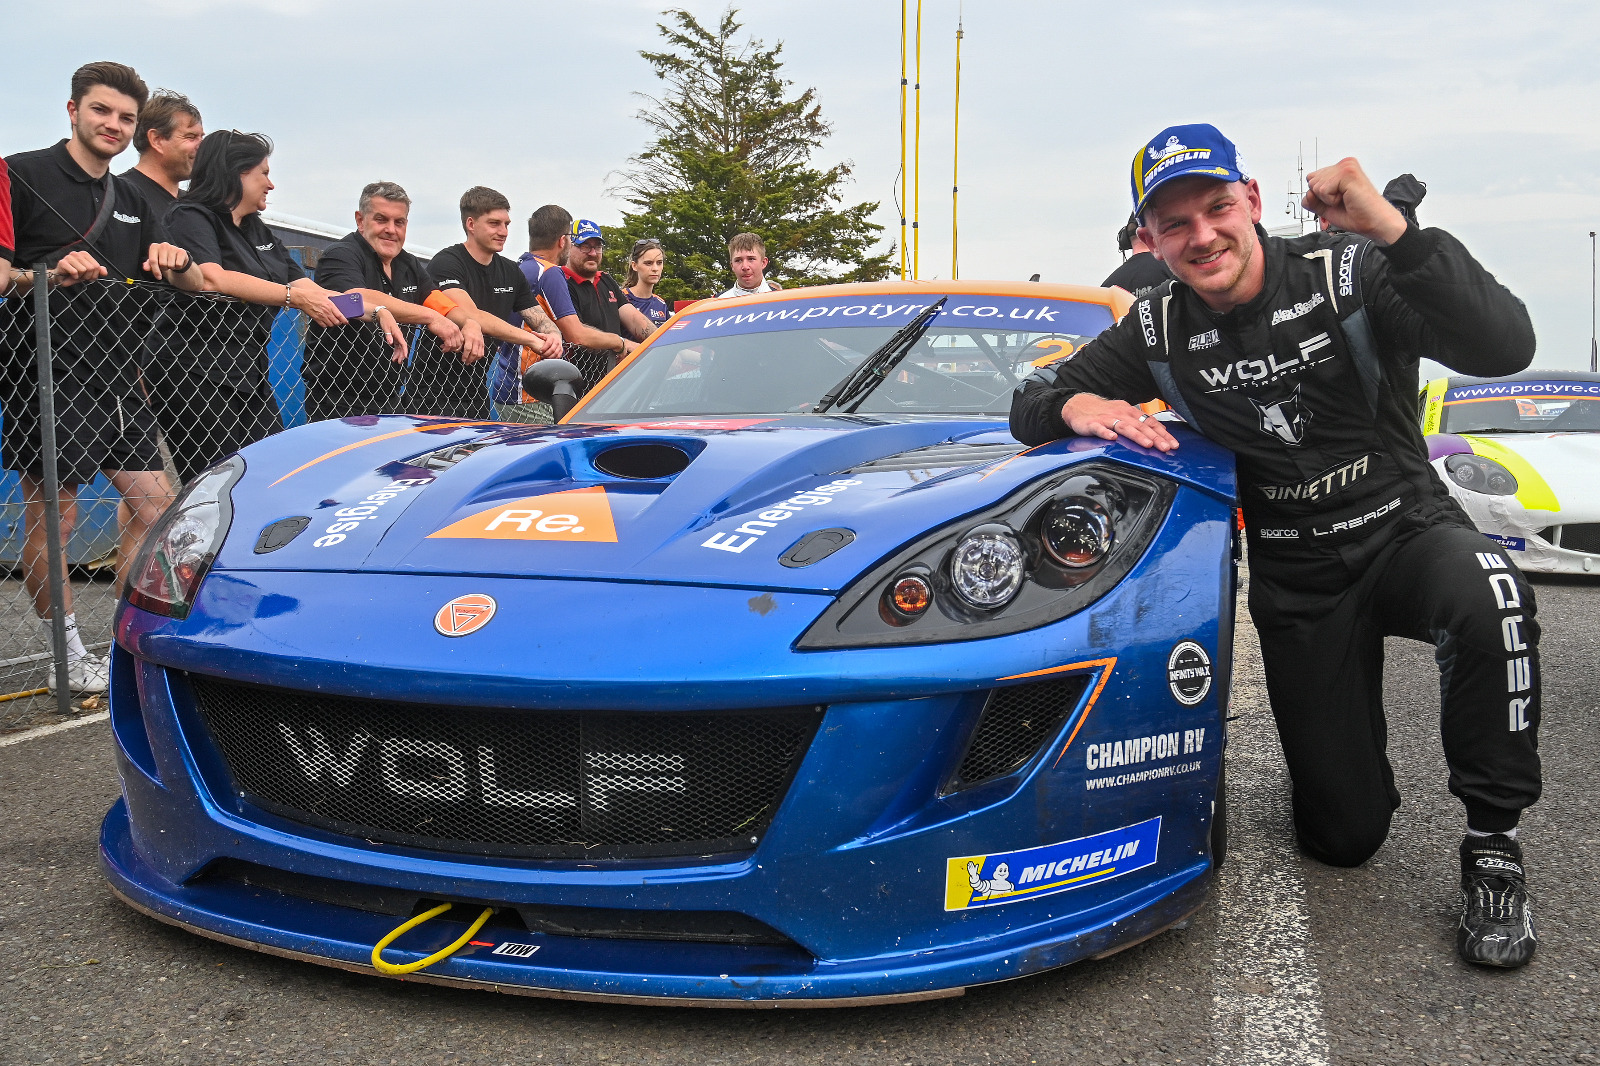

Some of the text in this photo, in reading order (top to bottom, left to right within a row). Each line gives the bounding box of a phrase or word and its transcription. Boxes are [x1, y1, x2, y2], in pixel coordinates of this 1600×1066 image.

[1144, 151, 1211, 187] MICHELIN
[1339, 244, 1357, 297] sparco
[703, 303, 1060, 329] www.protyre.co.uk
[1138, 299, 1157, 347] sparco
[1199, 331, 1331, 387] WOLF
[1453, 383, 1600, 398] www.protyre.c
[312, 477, 435, 548] Energise
[484, 509, 585, 533] Re.
[700, 478, 864, 554] Energise
[1312, 497, 1402, 537] L.READE
[1260, 528, 1300, 539] sparco
[1475, 552, 1531, 732] READE
[1169, 666, 1211, 681] INFINITY WAX
[278, 722, 687, 811] WOLF
[1086, 727, 1205, 770] CHAMPION RV
[1085, 761, 1202, 791] WWW.CHAMPIONRV.CO.UK
[1018, 839, 1141, 885] MICHELIN
[499, 943, 537, 956] TOW
